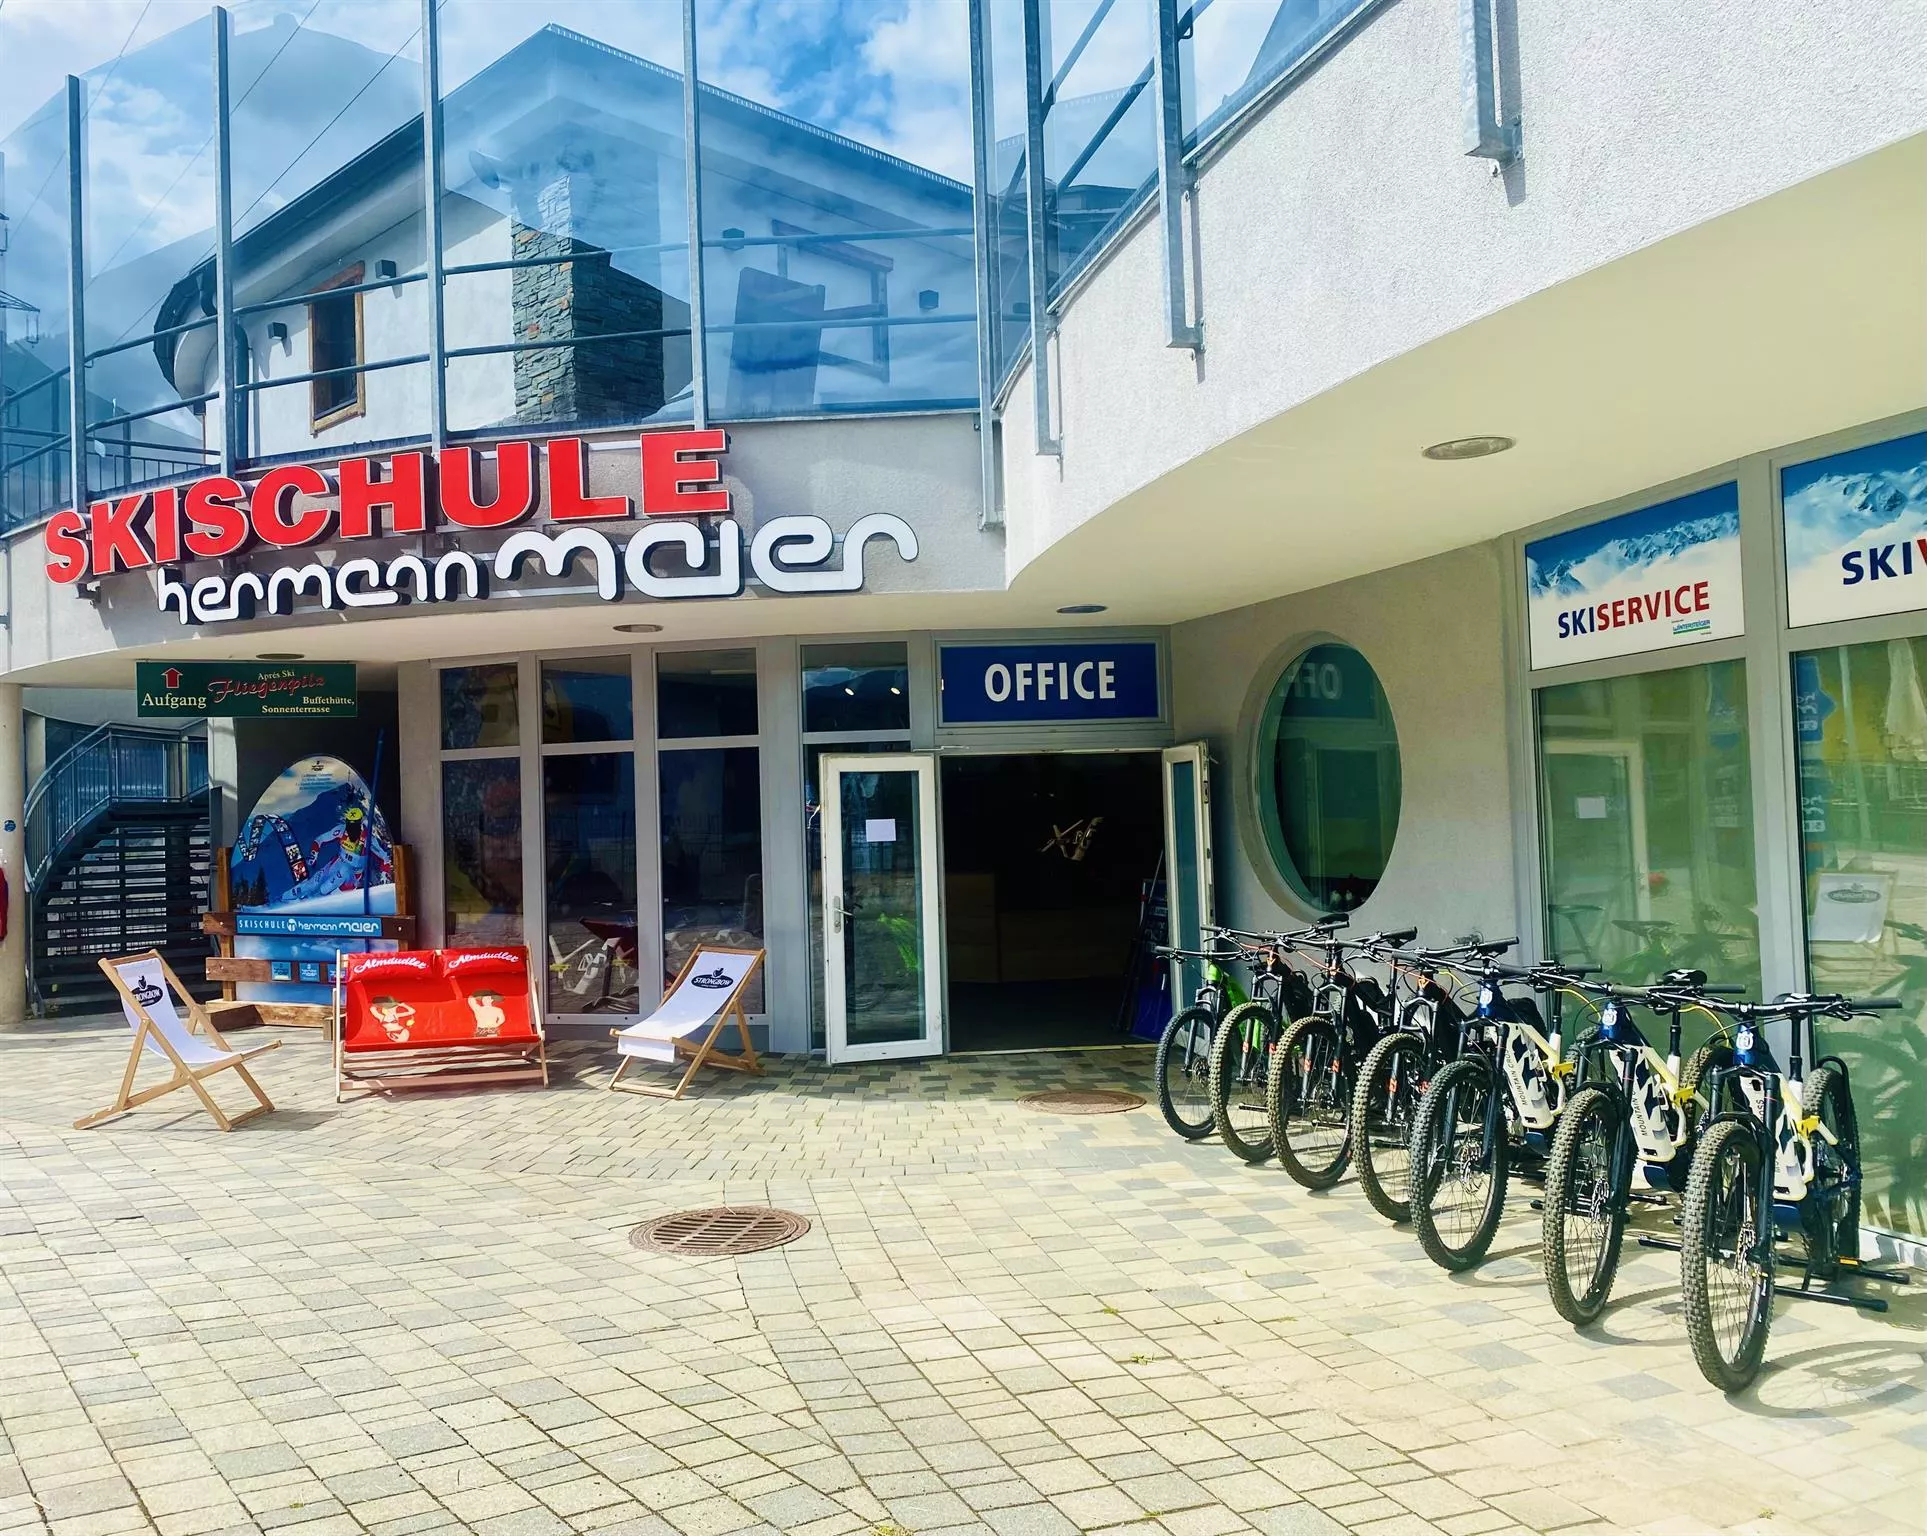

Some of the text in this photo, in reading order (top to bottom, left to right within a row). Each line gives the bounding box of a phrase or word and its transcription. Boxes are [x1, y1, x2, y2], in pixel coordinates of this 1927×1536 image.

[45, 429, 731, 584] SKISCHULE
[158, 513, 919, 625] hermann maier
[1558, 581, 1710, 639] SKISERVICE
[282, 669, 295, 678] Ski
[985, 661, 1116, 702] OFFICE
[142, 692, 207, 709] Aufgang
[262, 704, 330, 714] Sonnenterrasse
[303, 696, 355, 706] Buffethütte,
[239, 919, 379, 933] SKISCHULE hermann maier
[354, 956, 428, 974] Almdudler
[449, 951, 519, 969] Almdudler
[694, 977, 732, 985] STRONGBOW
[134, 989, 160, 1001] RONGBOW
[1511, 1070, 1528, 1105] MOUNTAIN
[1633, 1097, 1648, 1136] MOUNTAIN
